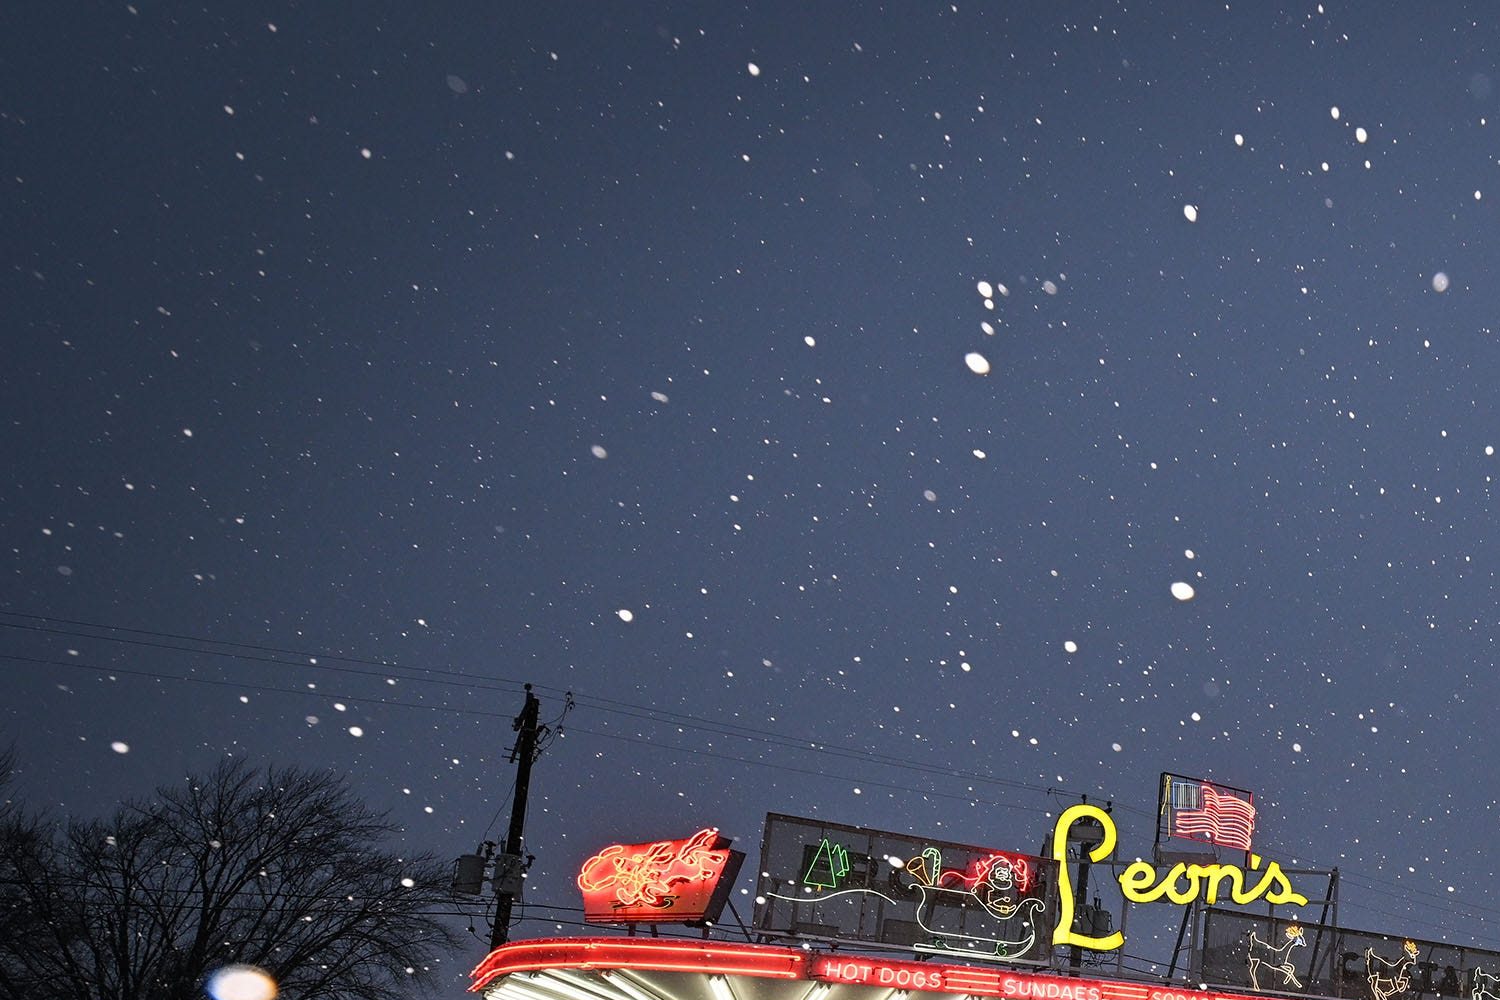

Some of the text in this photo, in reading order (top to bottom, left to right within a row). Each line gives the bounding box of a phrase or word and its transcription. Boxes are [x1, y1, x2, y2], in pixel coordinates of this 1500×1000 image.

[1052, 804, 1309, 951] Leon's
[826, 963, 942, 989] HOT DOGS
